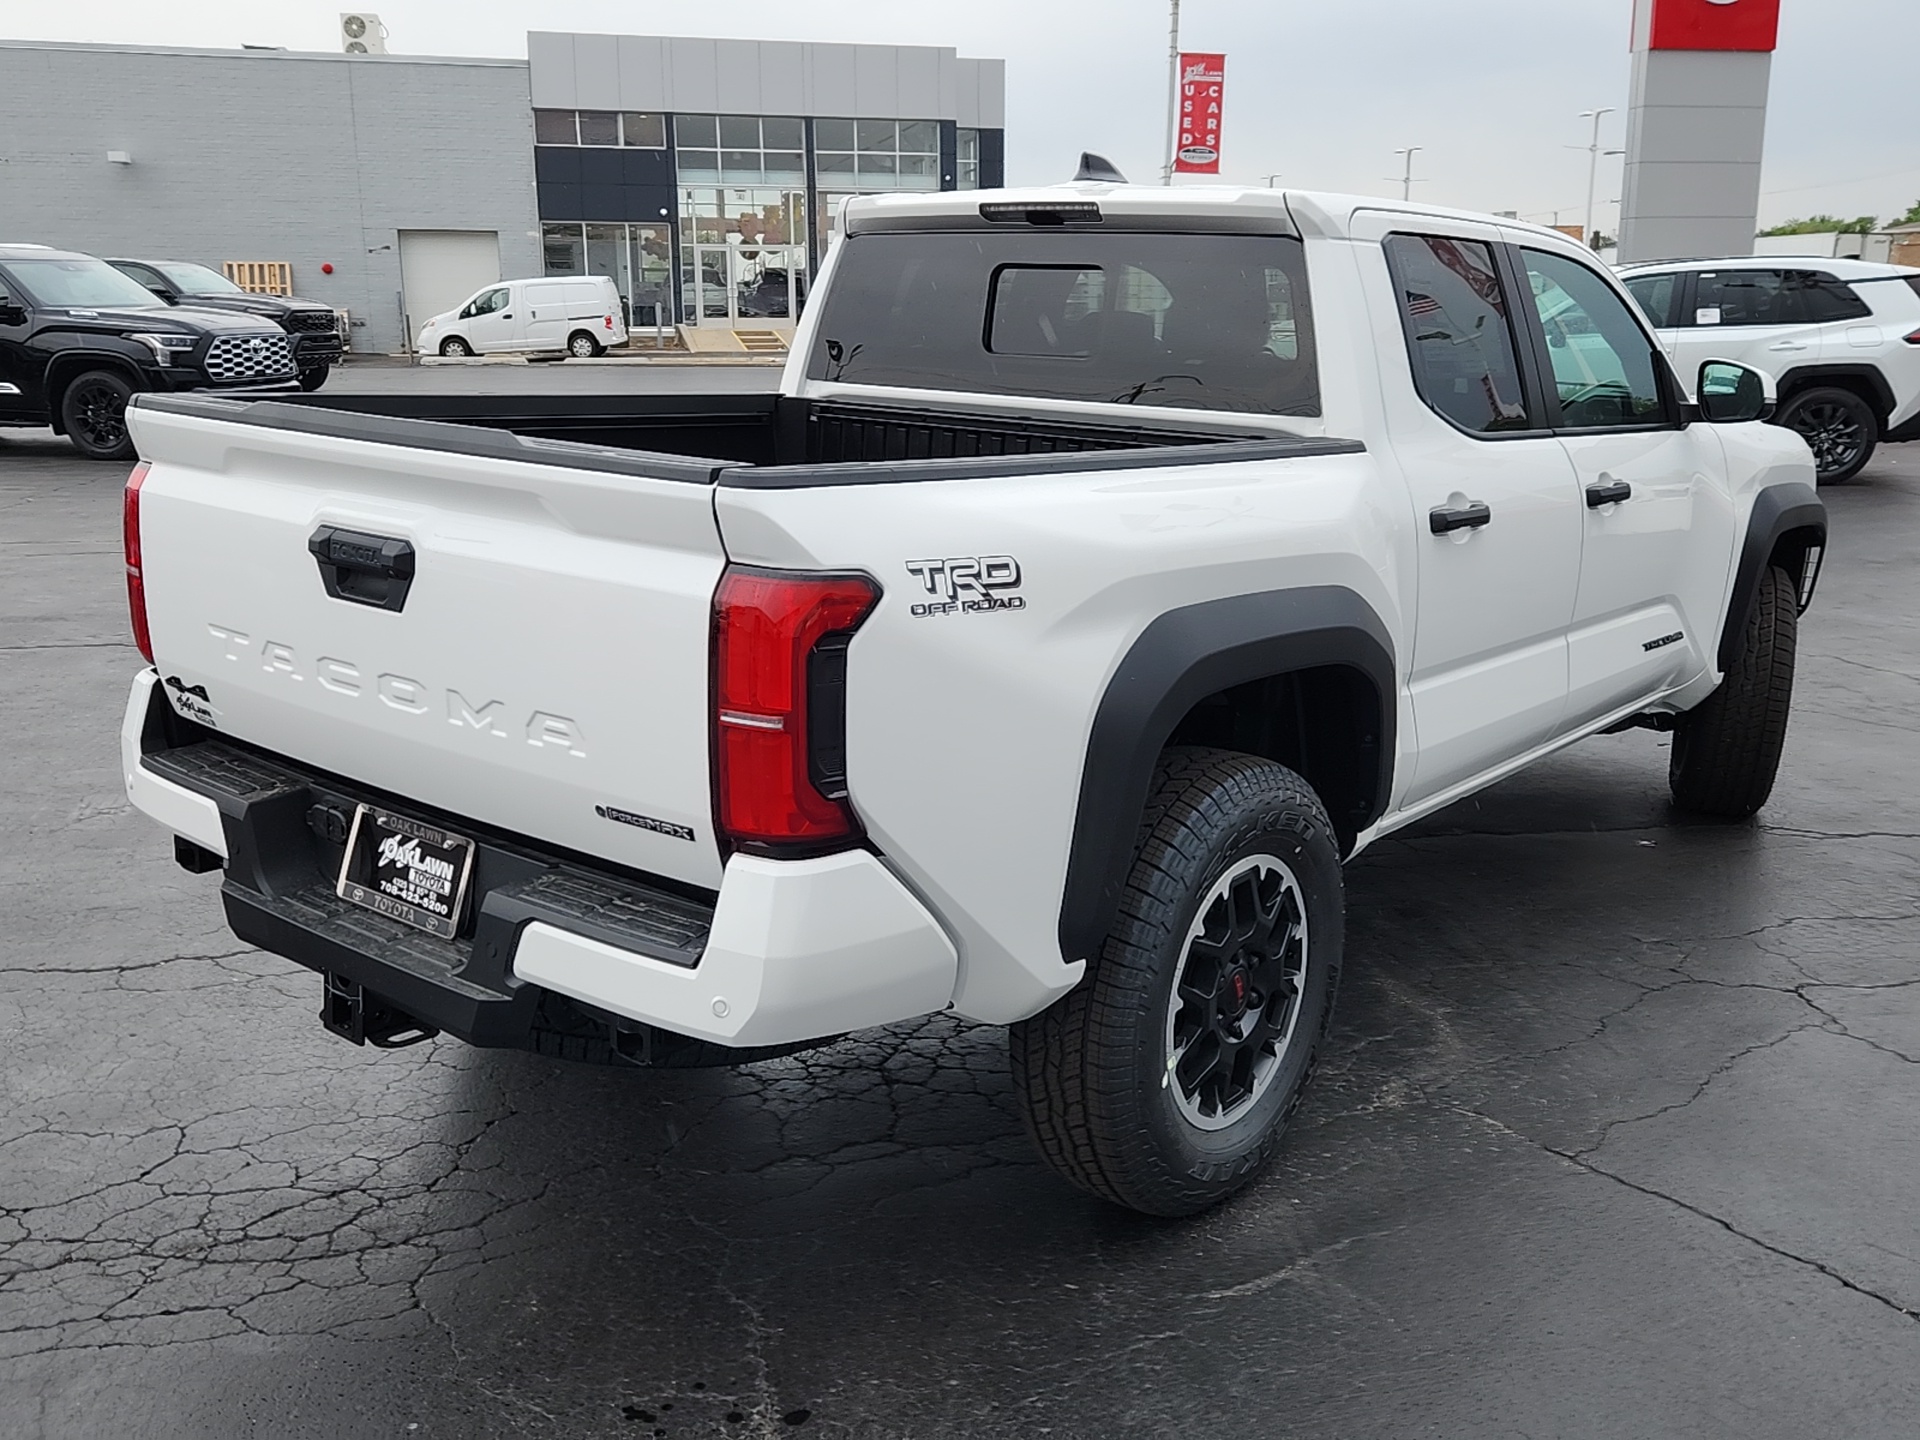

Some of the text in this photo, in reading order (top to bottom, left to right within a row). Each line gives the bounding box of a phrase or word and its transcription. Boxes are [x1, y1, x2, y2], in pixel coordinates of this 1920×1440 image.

[1182, 85, 1195, 145] USED
[1206, 86, 1219, 146] CARS
[905, 555, 1023, 601] TRD
[910, 597, 1026, 618] OFF ROAD
[207, 622, 588, 758] TACOMA
[389, 816, 442, 844] OAK LAWN
[380, 880, 449, 915] 708-423-5200
[413, 870, 446, 893] TOYOTA
[374, 895, 415, 922] TOYOTA
